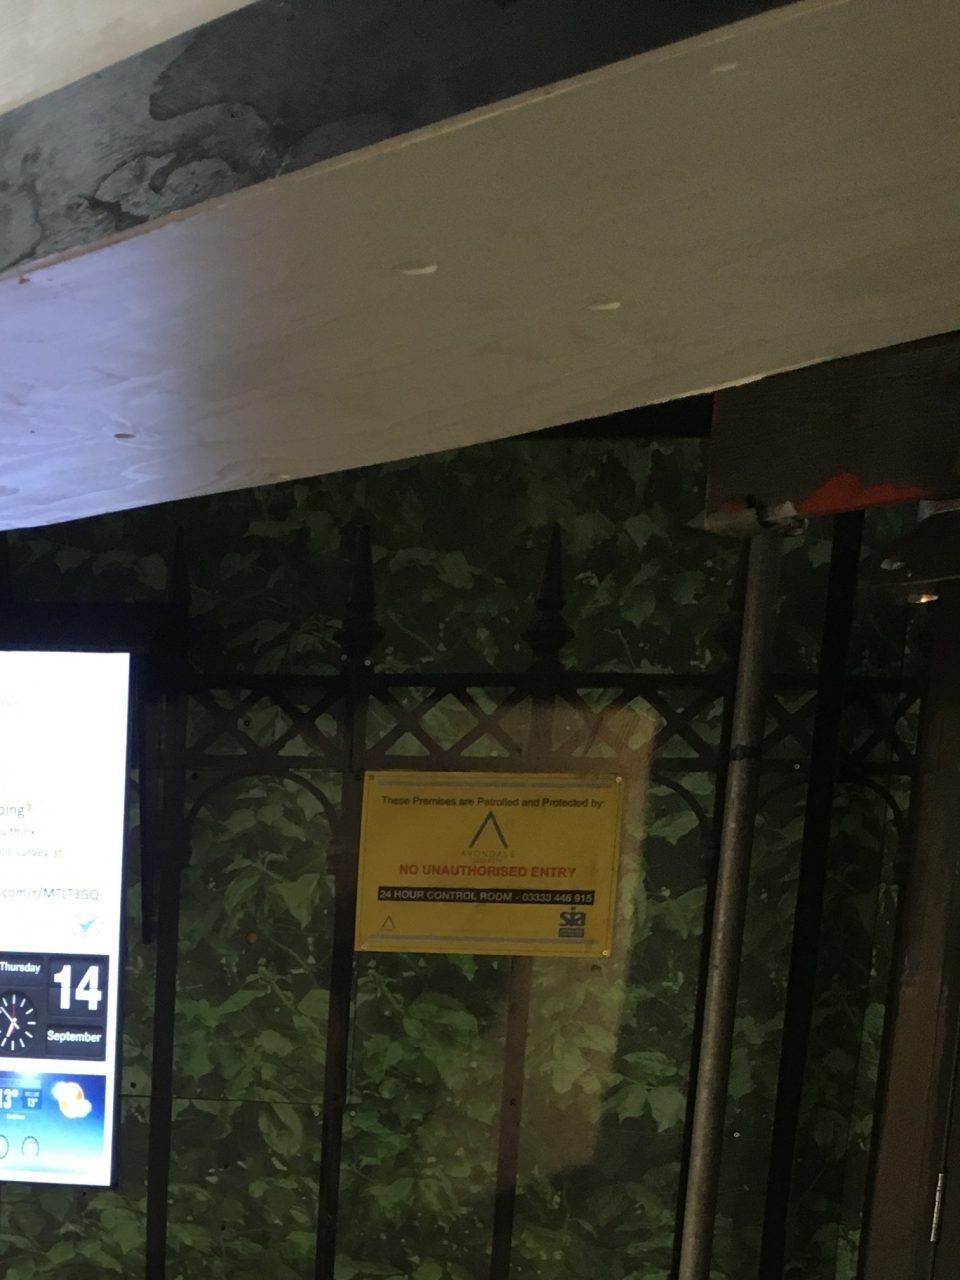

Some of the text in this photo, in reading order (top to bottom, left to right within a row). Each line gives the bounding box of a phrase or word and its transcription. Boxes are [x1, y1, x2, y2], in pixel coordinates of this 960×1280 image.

[382, 796, 410, 806] These
[413, 796, 456, 807] Premises
[459, 799, 474, 807] are
[478, 797, 519, 808] Patrolled
[522, 798, 540, 808] and
[542, 799, 588, 809] Protected
[400, 863, 577, 879] NO UNAUTHORISED ENTRY
[379, 889, 392, 900] 24
[394, 890, 424, 901] HOUR
[427, 891, 477, 902] CONTROL
[480, 892, 513, 903] ROOM
[522, 893, 552, 904] 03333
[574, 894, 593, 905] 915
[0, 961, 41, 974] Thursday
[53, 964, 102, 1011] 14
[47, 1030, 102, 1043] September
